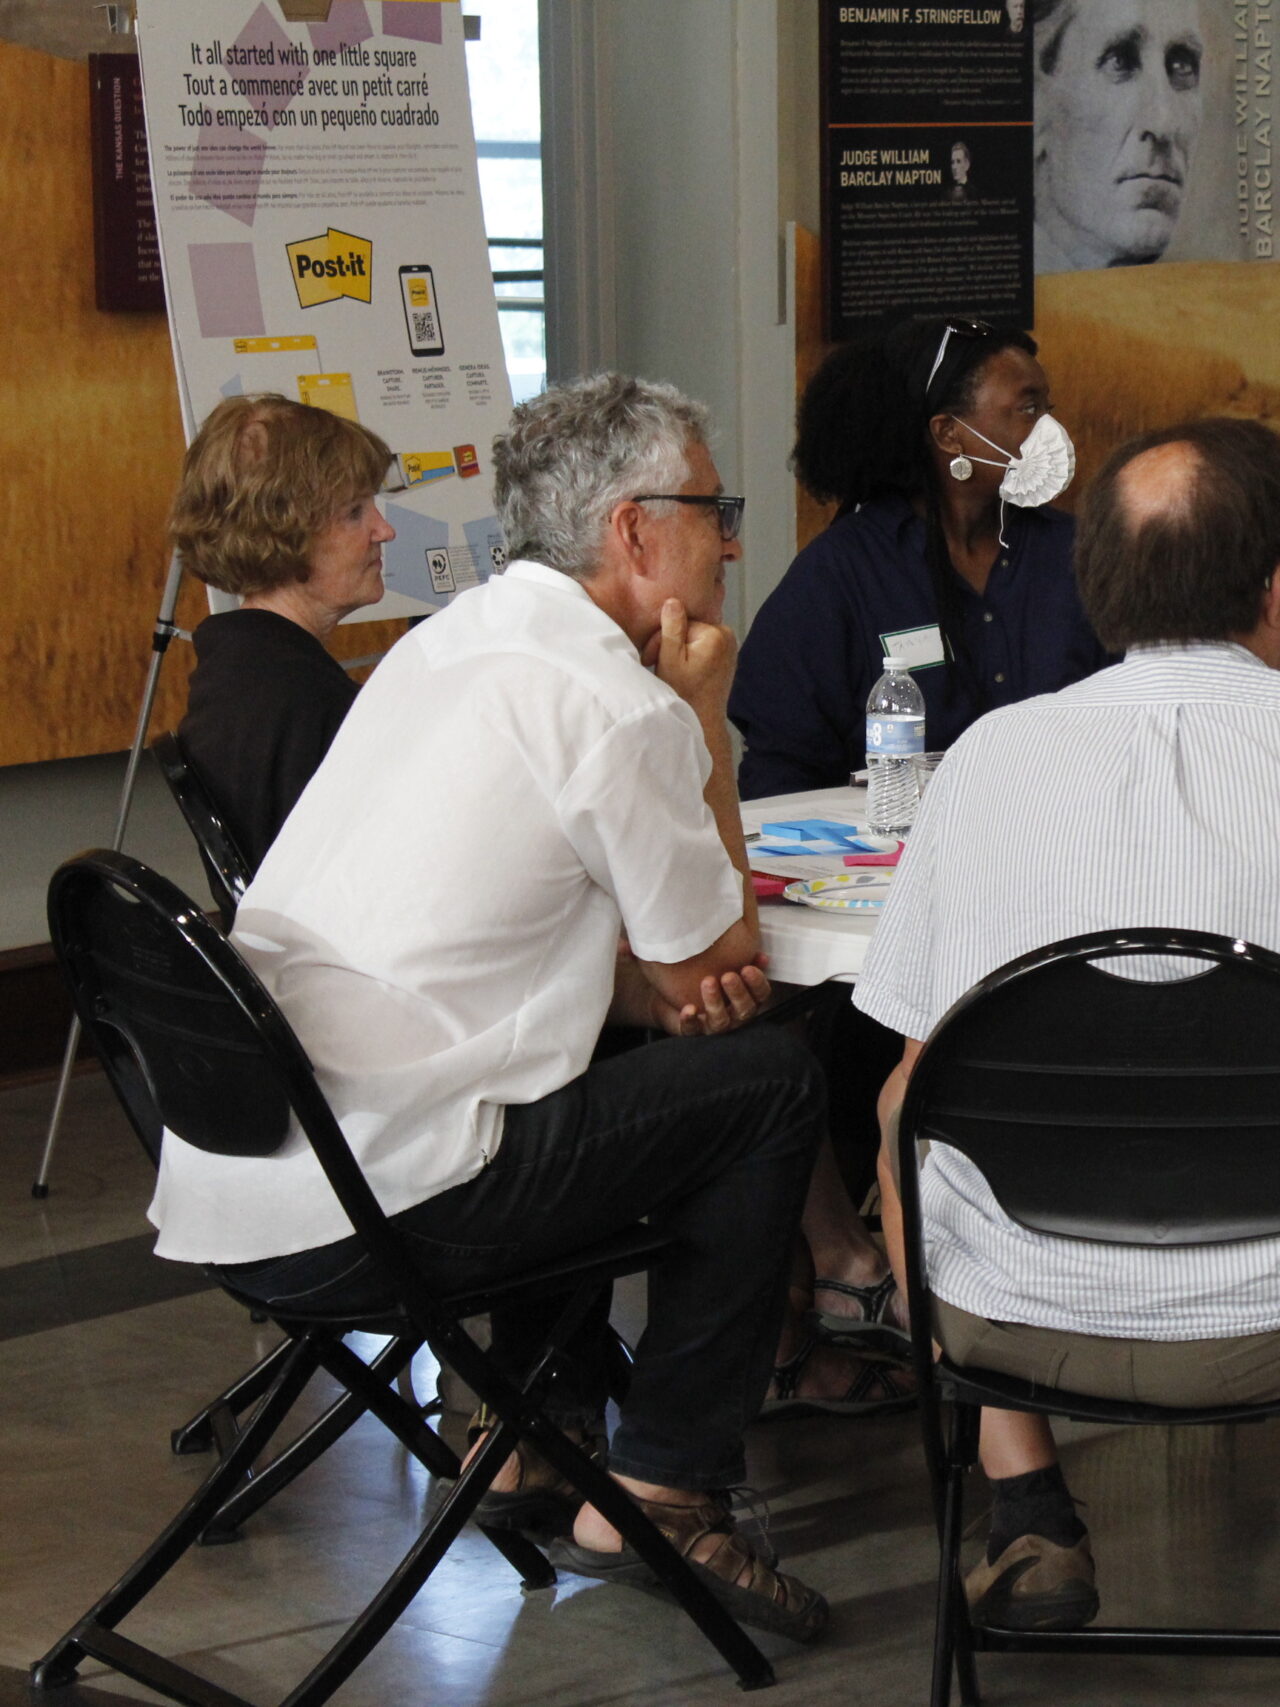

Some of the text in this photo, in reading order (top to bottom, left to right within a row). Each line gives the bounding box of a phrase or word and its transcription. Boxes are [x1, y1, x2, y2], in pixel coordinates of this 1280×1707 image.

[839, 7, 1002, 24] BENJAMIN F. STRINGFELLOW
[191, 40, 417, 72] It all started with one little square
[183, 71, 429, 101] Tout a commencé avec un petit carré
[113, 77, 123, 180] THE KANSAS QUESTION
[178, 101, 440, 131] Todo empezó con un pequeño cuadrado
[1234, 0, 1249, 239] JUDGE WILLIA
[840, 149, 929, 165] JUDGE WILLIAM
[840, 169, 942, 187] BARCLAY NAPTON
[1254, 106, 1272, 257] BARCLAY
[296, 251, 366, 278] Post-it
